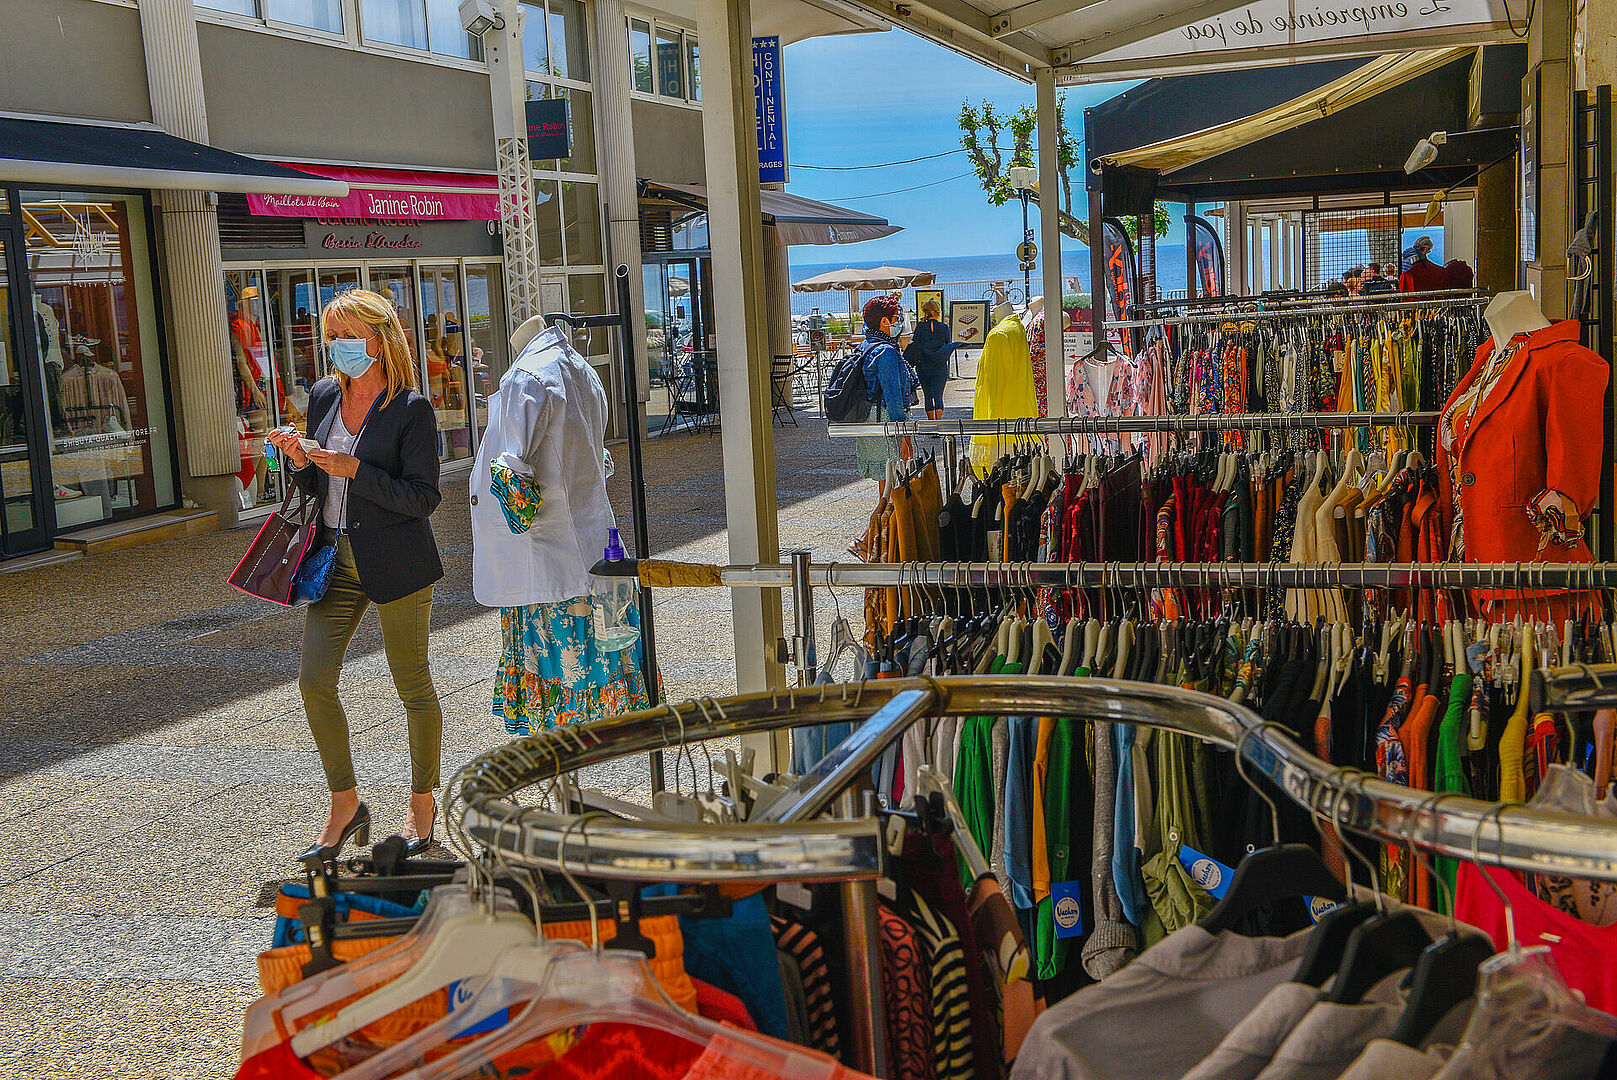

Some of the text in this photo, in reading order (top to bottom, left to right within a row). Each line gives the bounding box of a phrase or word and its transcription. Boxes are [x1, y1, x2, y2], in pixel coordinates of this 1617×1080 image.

[764, 52, 776, 150] CONTINENTAL
[758, 160, 783, 169] RAGES
[263, 193, 341, 208] Maillots de Bain
[368, 194, 444, 216] Janine Robin
